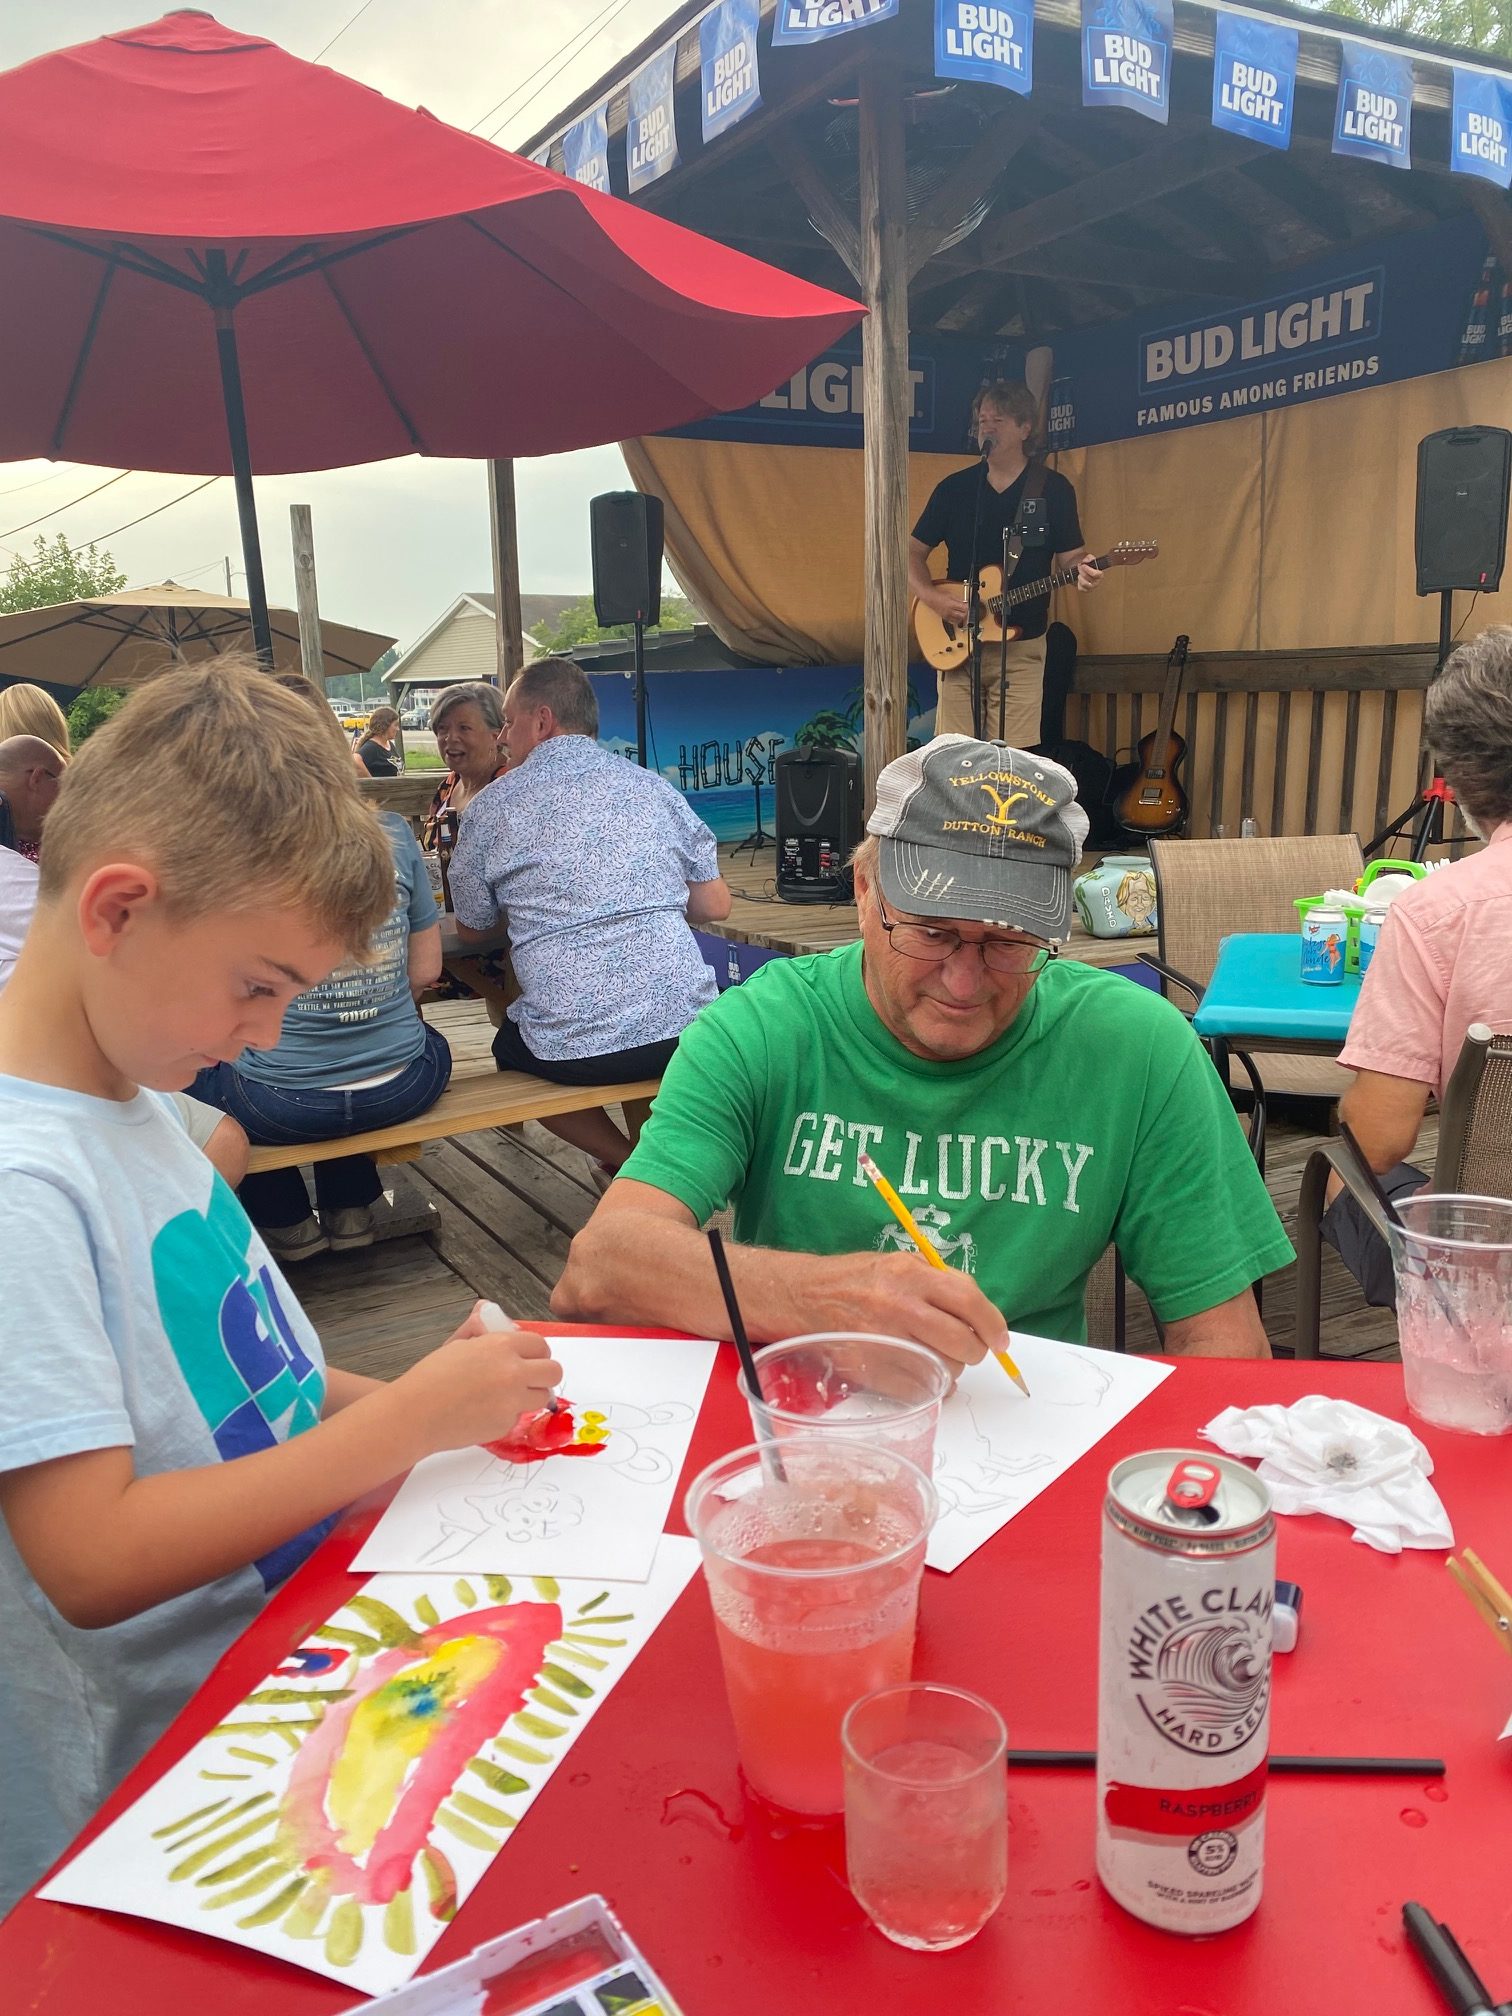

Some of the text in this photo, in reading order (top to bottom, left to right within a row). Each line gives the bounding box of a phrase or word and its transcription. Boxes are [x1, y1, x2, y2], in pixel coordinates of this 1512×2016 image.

[958, 3, 1014, 39] BUD
[714, 41, 747, 87] BUD
[946, 28, 1023, 71] LIGHT
[1104, 34, 1152, 69] BUD
[707, 62, 753, 117] LIGHT
[1094, 58, 1161, 98] LIGHT
[1232, 61, 1278, 98] BUD
[1221, 83, 1284, 126] LIGHT
[1356, 88, 1398, 121] BUD
[639, 105, 665, 144] BUD
[1344, 110, 1403, 148] LIGHT
[1468, 112, 1503, 142] BUD
[632, 123, 670, 170] LIGHT
[1461, 132, 1508, 167] LIGHT
[575, 158, 599, 185] BUD
[1146, 281, 1374, 383] BUD LIGHT
[1466, 324, 1487, 334] BUD
[1498, 323, 1512, 336] LIG
[1500, 313, 1512, 326] BU
[1461, 334, 1486, 344] LIGHT
[760, 362, 924, 417] LIG
[1137, 355, 1379, 426] FAMOUS AMONG FRIENDS
[1048, 416, 1075, 433] LIGHT
[1050, 404, 1074, 419] BUD
[949, 770, 1057, 807] YELLOWSTONE
[942, 821, 1047, 848] DUTTON RANCH
[1101, 886, 1117, 928] DAVID
[783, 1112, 1095, 1214] GET LUCKY
[1128, 1596, 1194, 1681] WHITE
[1155, 1708, 1222, 1748] HARD
[1159, 1790, 1257, 1819] RASPBERRY
